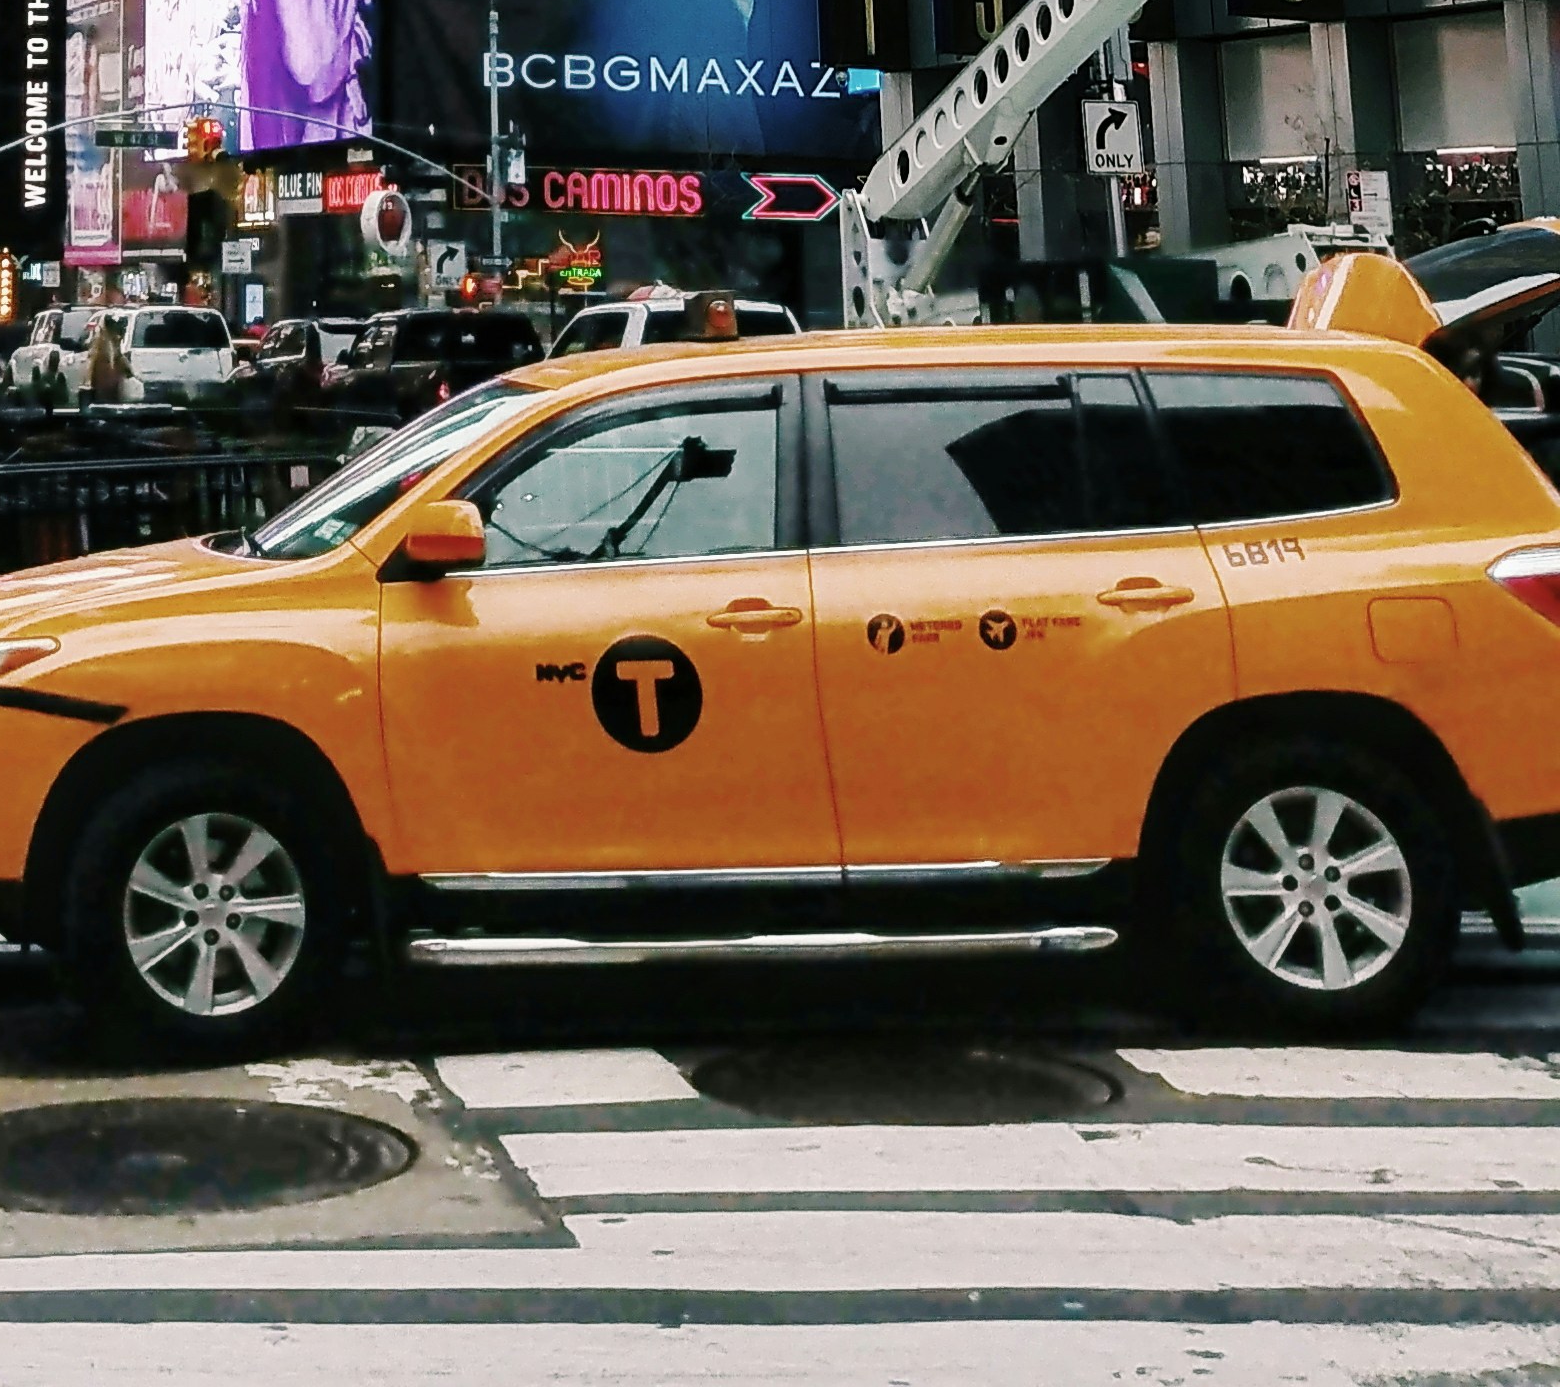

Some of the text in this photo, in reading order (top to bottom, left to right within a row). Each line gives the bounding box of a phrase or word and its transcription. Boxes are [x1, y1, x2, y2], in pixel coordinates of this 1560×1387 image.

[26, 33, 49, 67] TO
[23, 81, 49, 208] WELCOME
[1094, 152, 1135, 169] ONLY
[278, 171, 323, 199] BLUE FIN
[462, 167, 703, 214] DS CAMINOS
[535, 662, 587, 686] NYC
[615, 658, 676, 739] T
